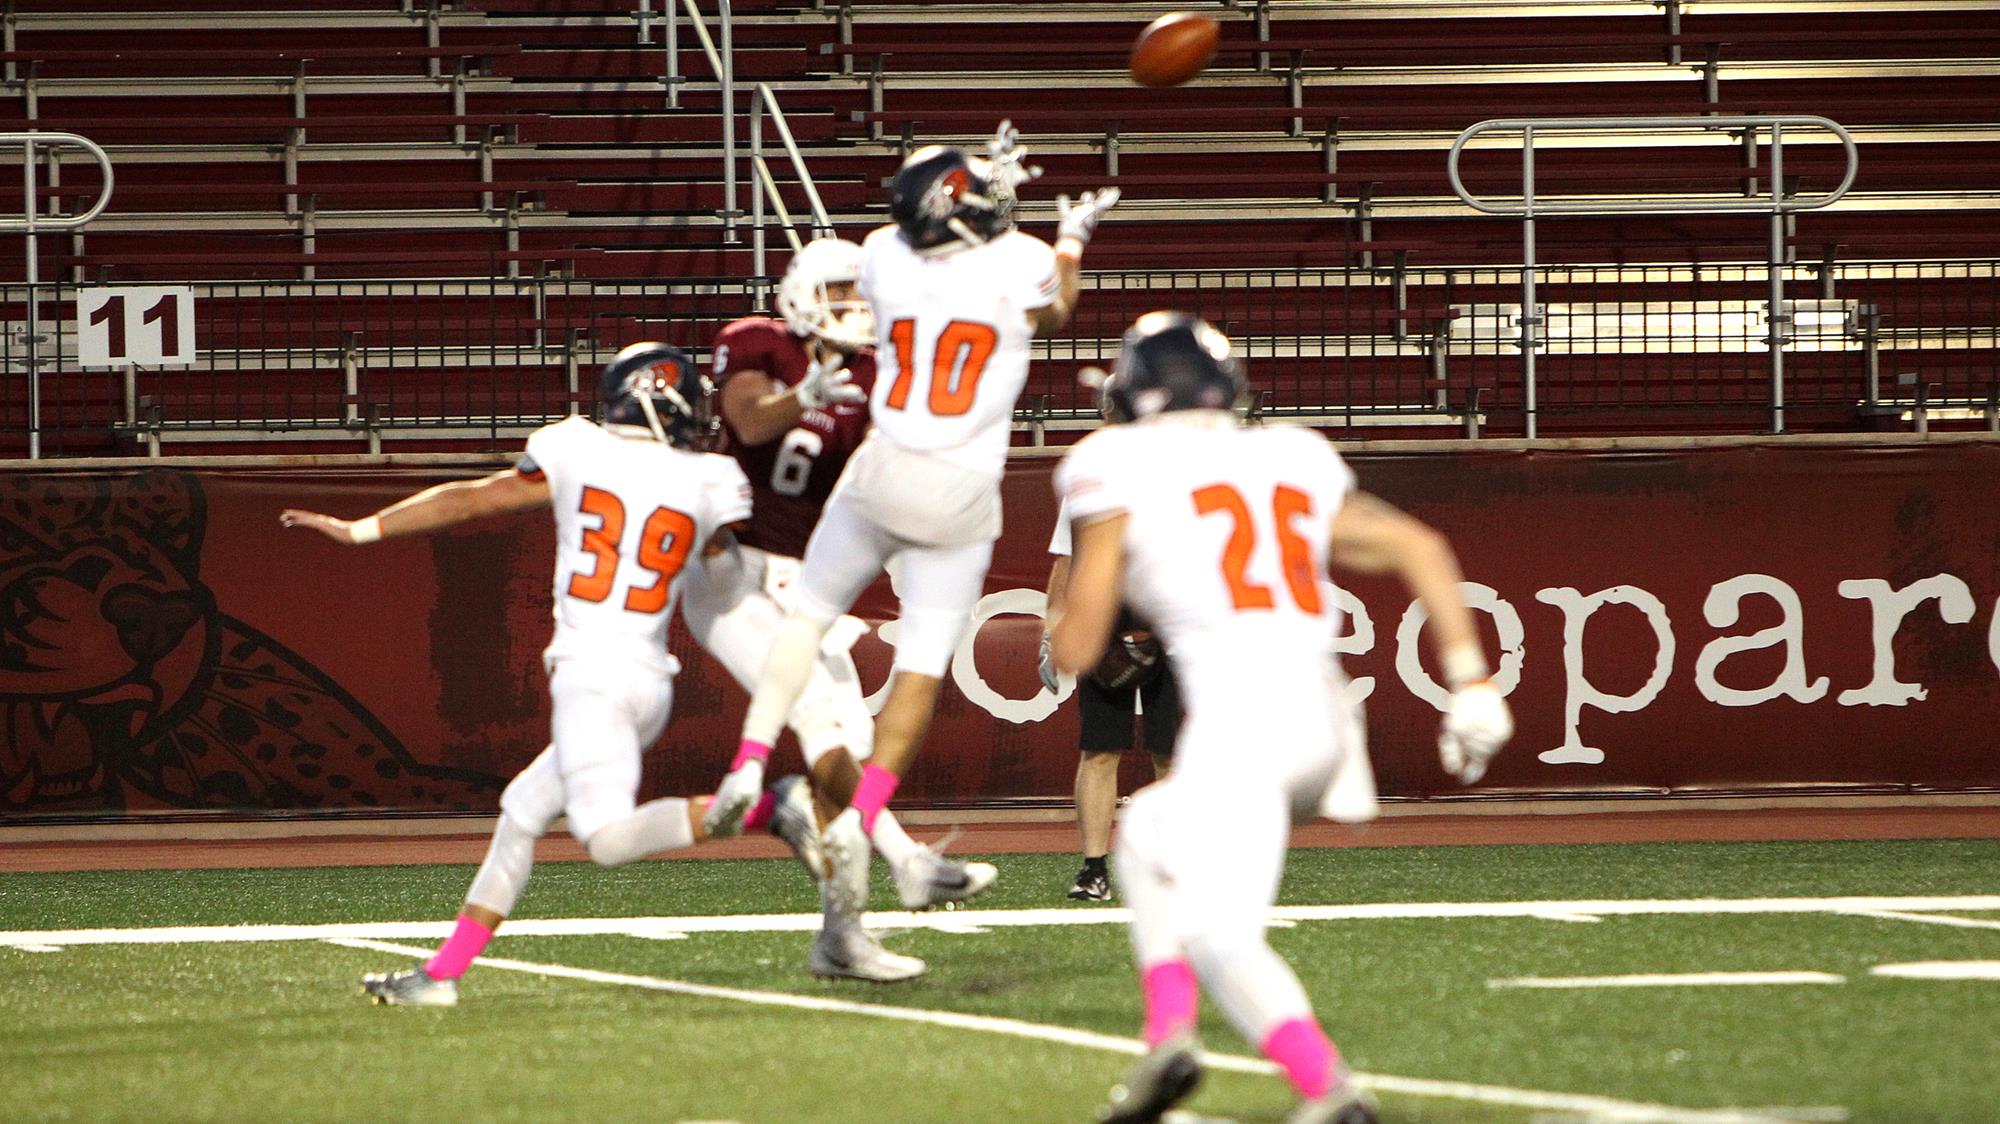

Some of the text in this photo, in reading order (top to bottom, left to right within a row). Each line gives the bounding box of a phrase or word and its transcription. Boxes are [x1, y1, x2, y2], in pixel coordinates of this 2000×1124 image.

[90, 295, 179, 358] 11
[887, 318, 998, 416] 10
[771, 428, 823, 496] 6
[569, 486, 696, 614] 39
[1192, 483, 1323, 616] 26
[864, 554, 2000, 764] o opar
